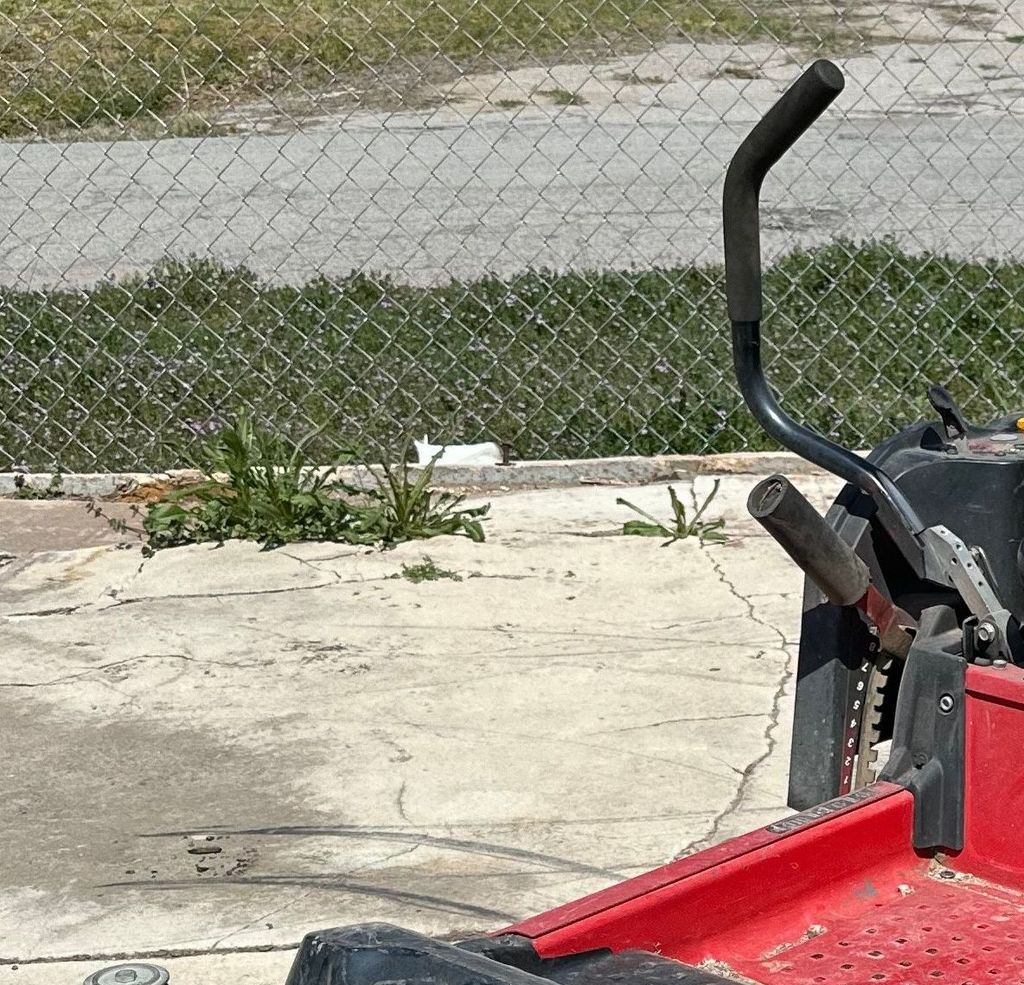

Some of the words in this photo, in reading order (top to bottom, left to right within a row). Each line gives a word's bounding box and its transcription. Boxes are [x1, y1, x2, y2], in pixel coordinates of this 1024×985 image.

[861, 662, 869, 672] 7
[856, 681, 864, 691] 6
[853, 700, 861, 710] 5
[850, 719, 857, 729] 4
[847, 738, 854, 747] 3
[844, 756, 851, 766] 2
